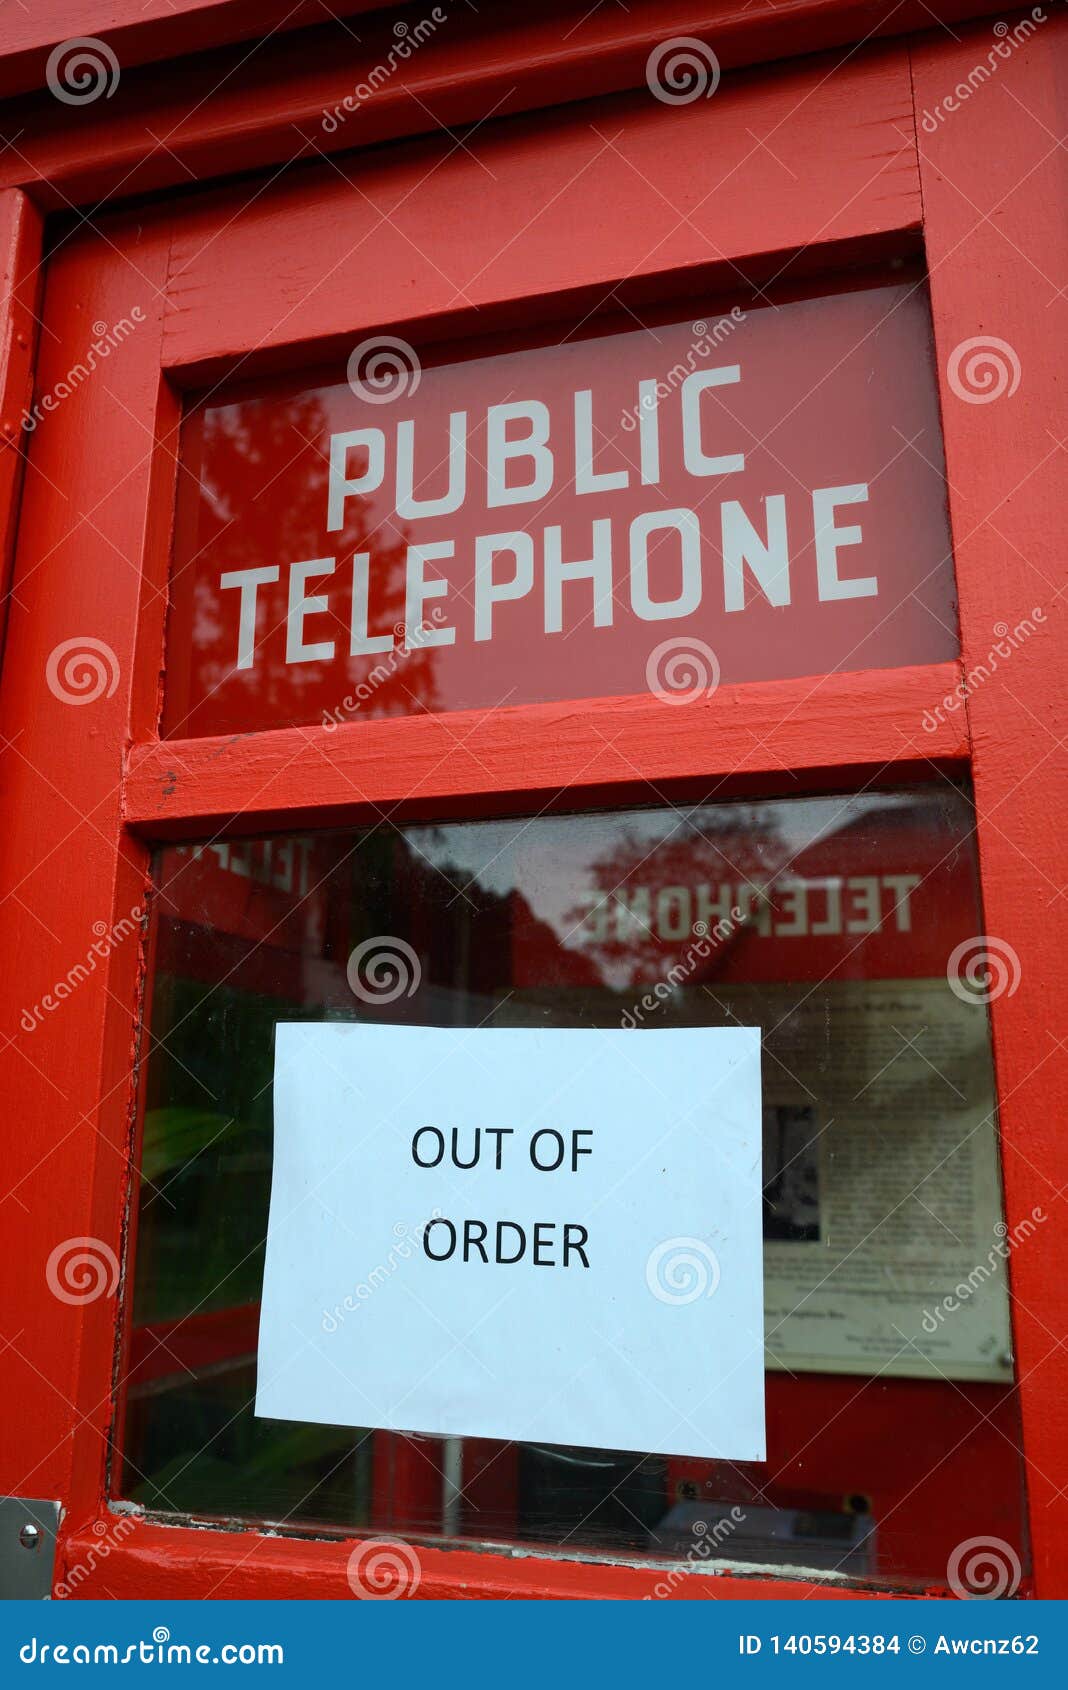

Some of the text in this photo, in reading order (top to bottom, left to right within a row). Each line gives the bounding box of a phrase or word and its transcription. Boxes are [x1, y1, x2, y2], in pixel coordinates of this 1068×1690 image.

[327, 364, 745, 532] PUBLIC
[220, 482, 879, 670] TELEPHONE
[411, 1126, 594, 1172] OUT OF
[422, 1217, 590, 1268] ORDER
